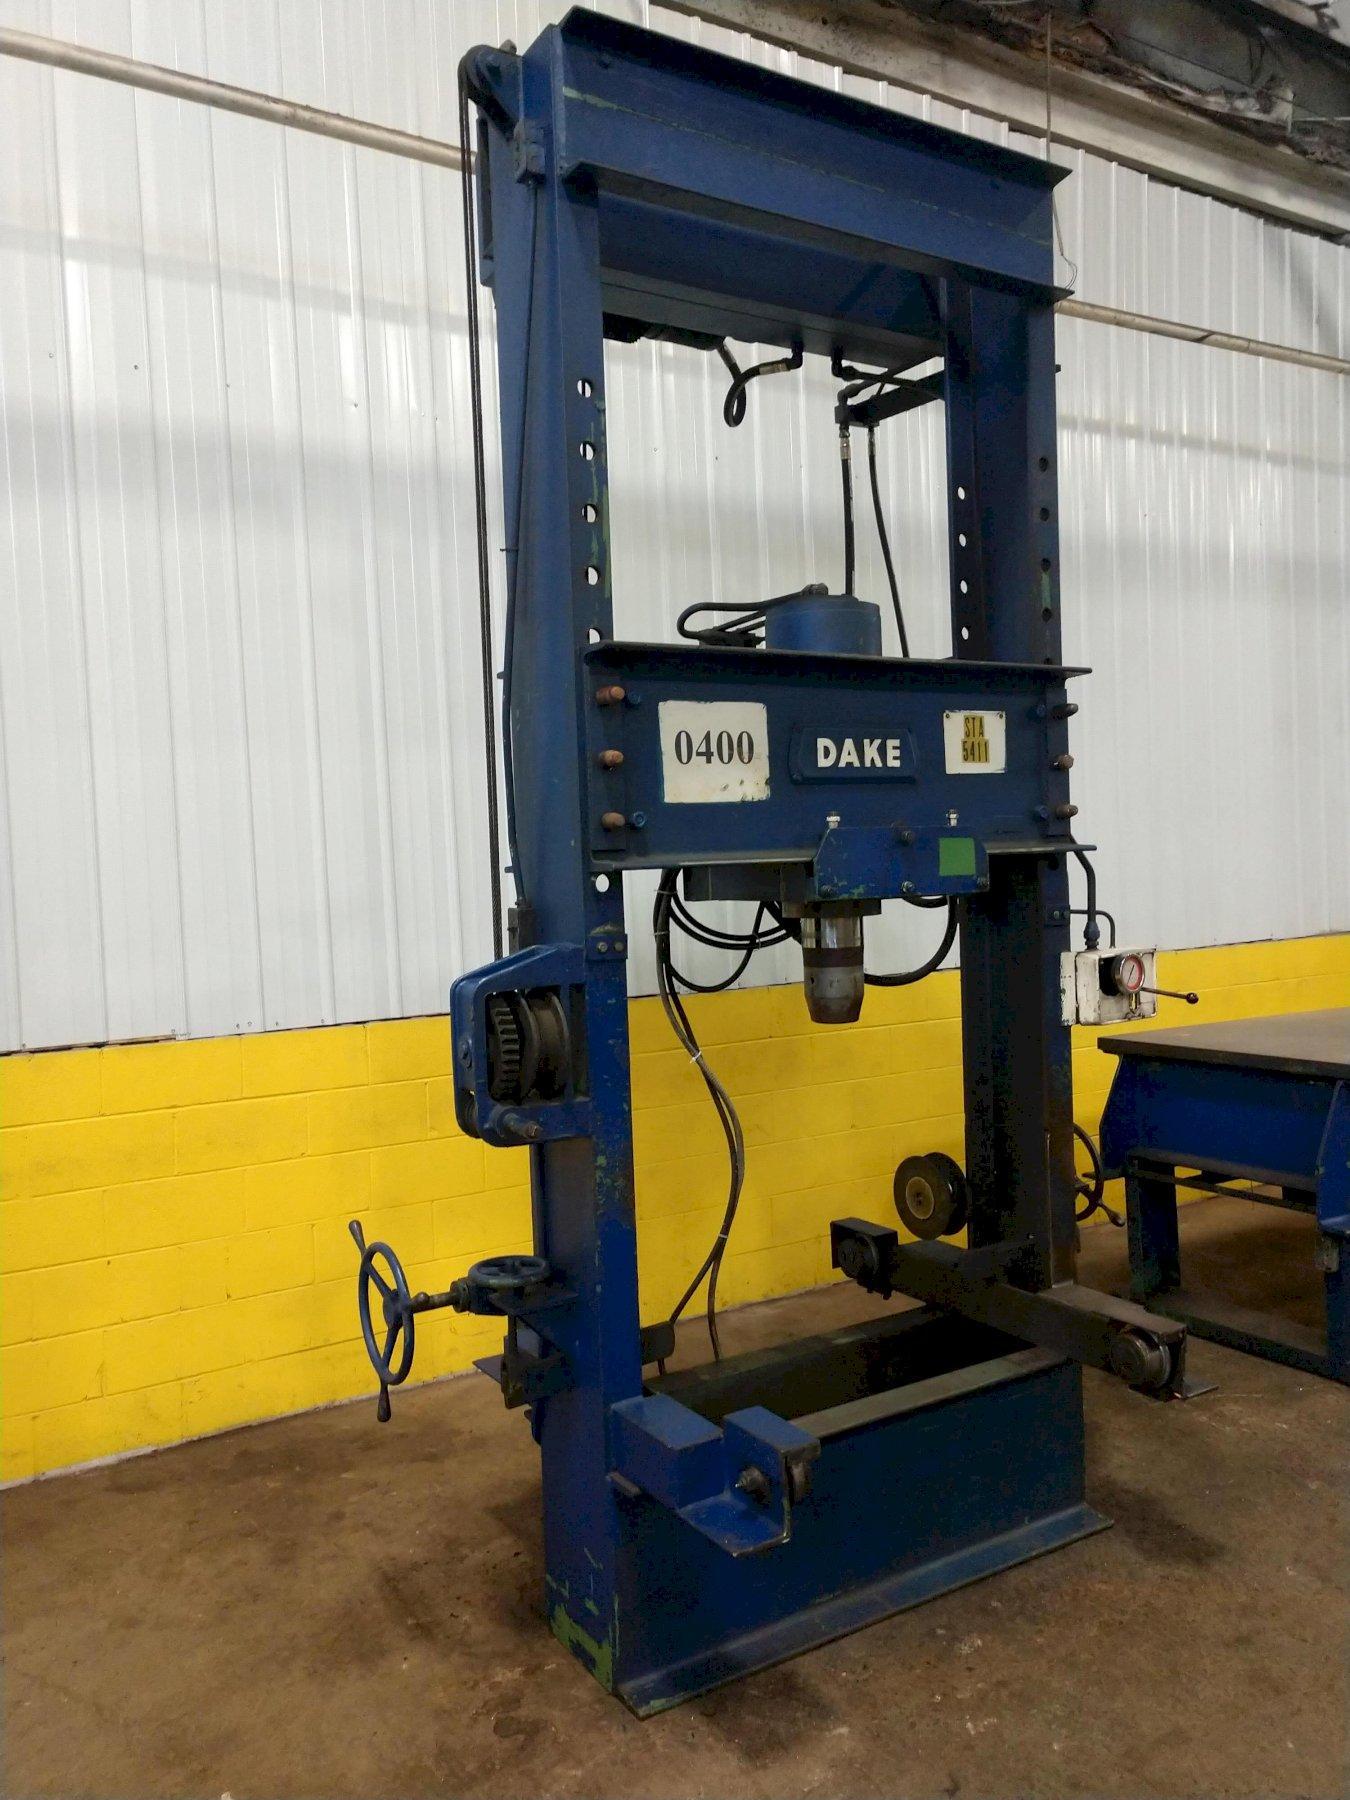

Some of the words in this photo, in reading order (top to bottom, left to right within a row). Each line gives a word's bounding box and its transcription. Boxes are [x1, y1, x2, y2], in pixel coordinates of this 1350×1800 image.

[964, 717, 984, 738] STA
[674, 730, 755, 765] 0400
[816, 737, 901, 768] DAKE
